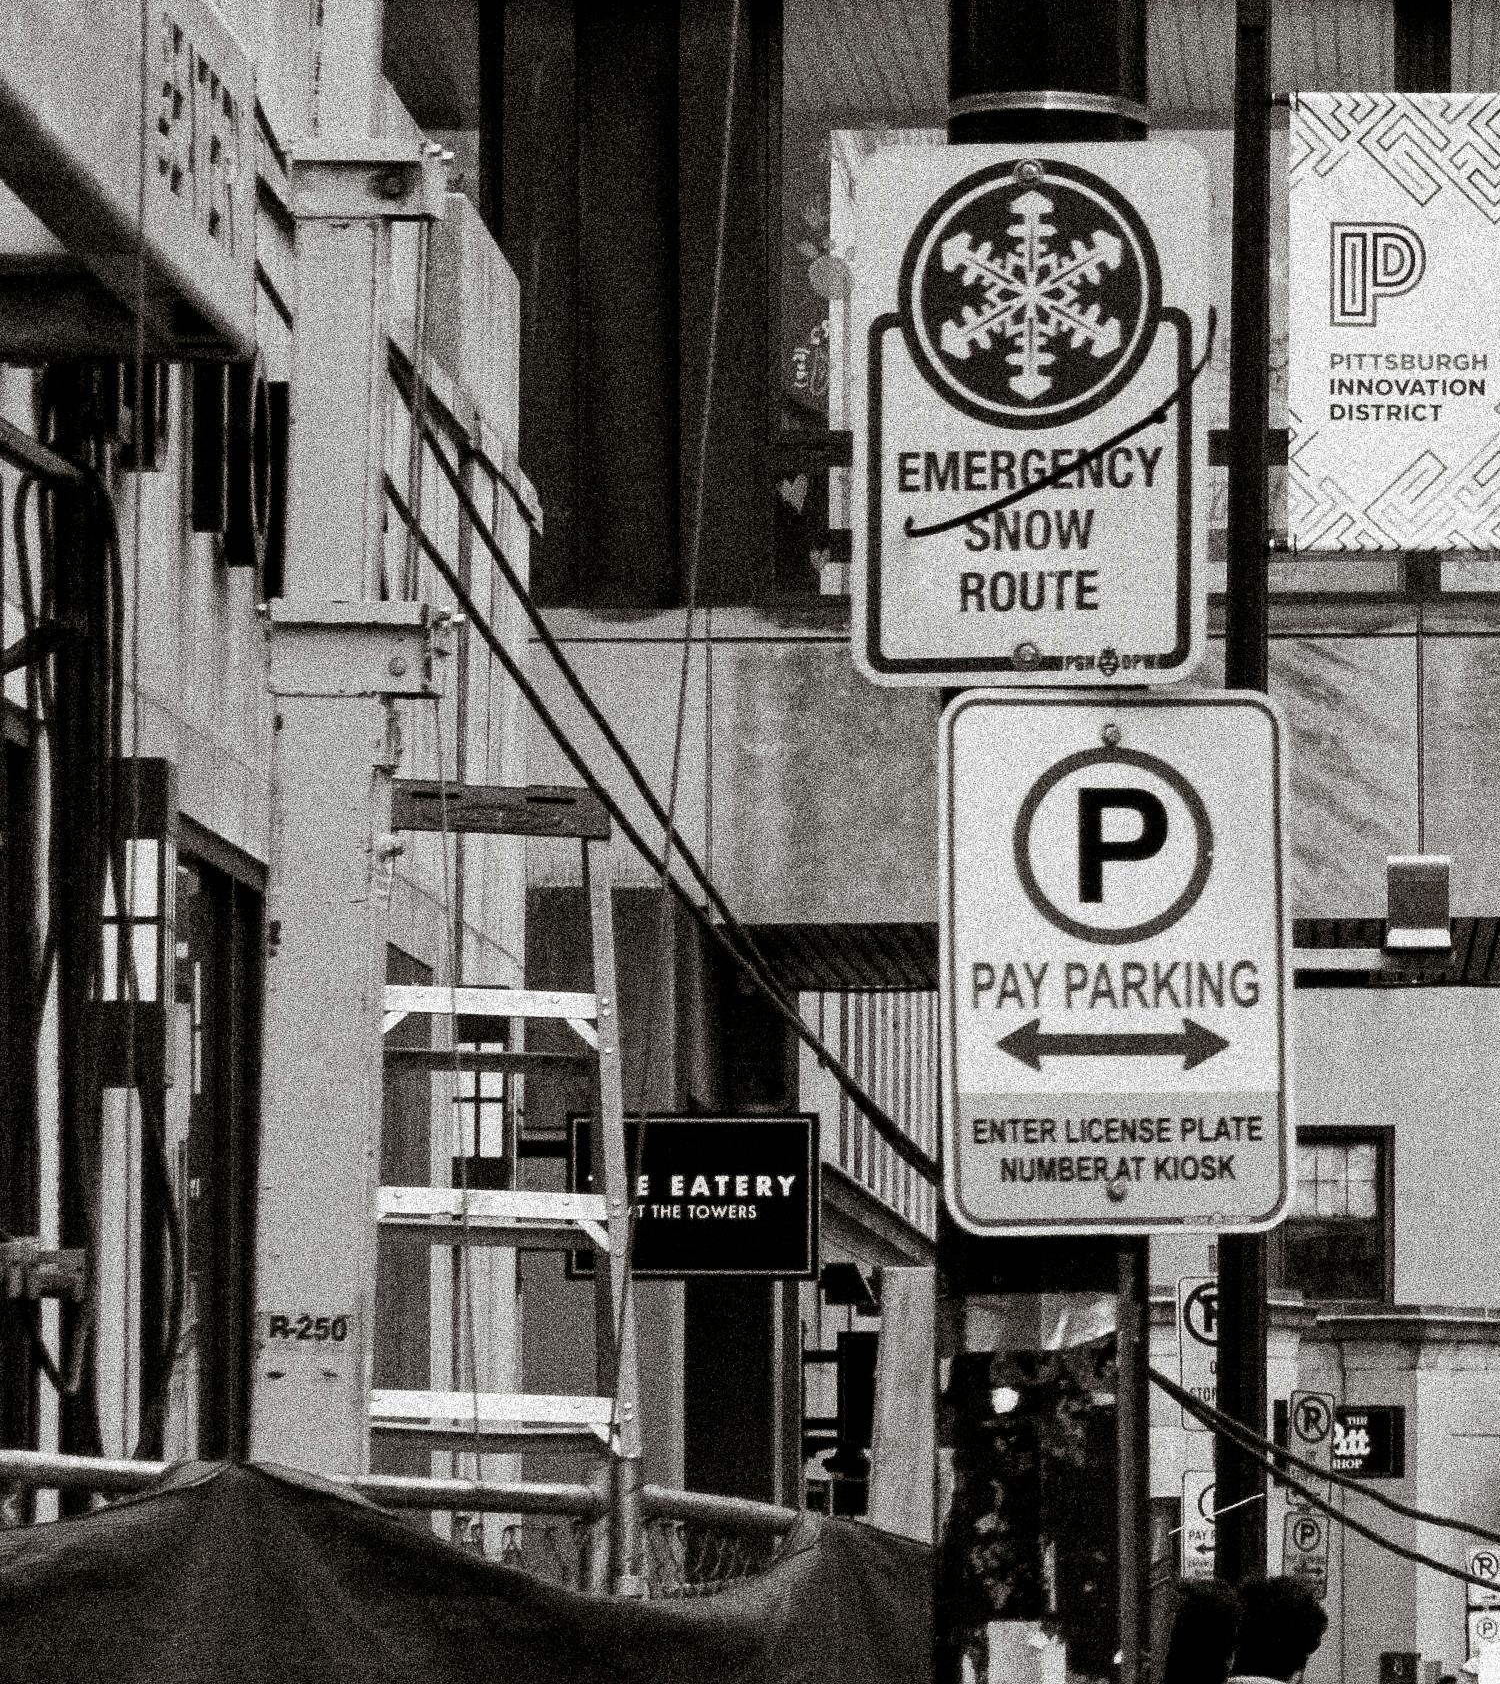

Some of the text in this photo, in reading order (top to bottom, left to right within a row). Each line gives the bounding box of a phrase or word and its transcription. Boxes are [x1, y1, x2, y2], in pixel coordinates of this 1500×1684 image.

[1329, 353, 1488, 372] PITTSBURGH
[1329, 378, 1487, 397] INNOVATION
[1329, 403, 1443, 423] DISTRICT
[898, 444, 1163, 496] EMERGENCY
[965, 507, 1093, 552] SNOW
[959, 569, 1099, 614] ROUTE
[1077, 786, 1169, 904] P
[971, 959, 1260, 1011] PAY PARKING
[973, 1117, 1263, 1145] ENTER LICENSE PLATE
[1001, 1156, 1236, 1184] NUMBER AT KIOSK
[671, 1175, 796, 1197] EATERY
[652, 1204, 681, 1220] THE
[688, 1204, 758, 1220] TOWERS
[268, 1314, 348, 1342] R-250
